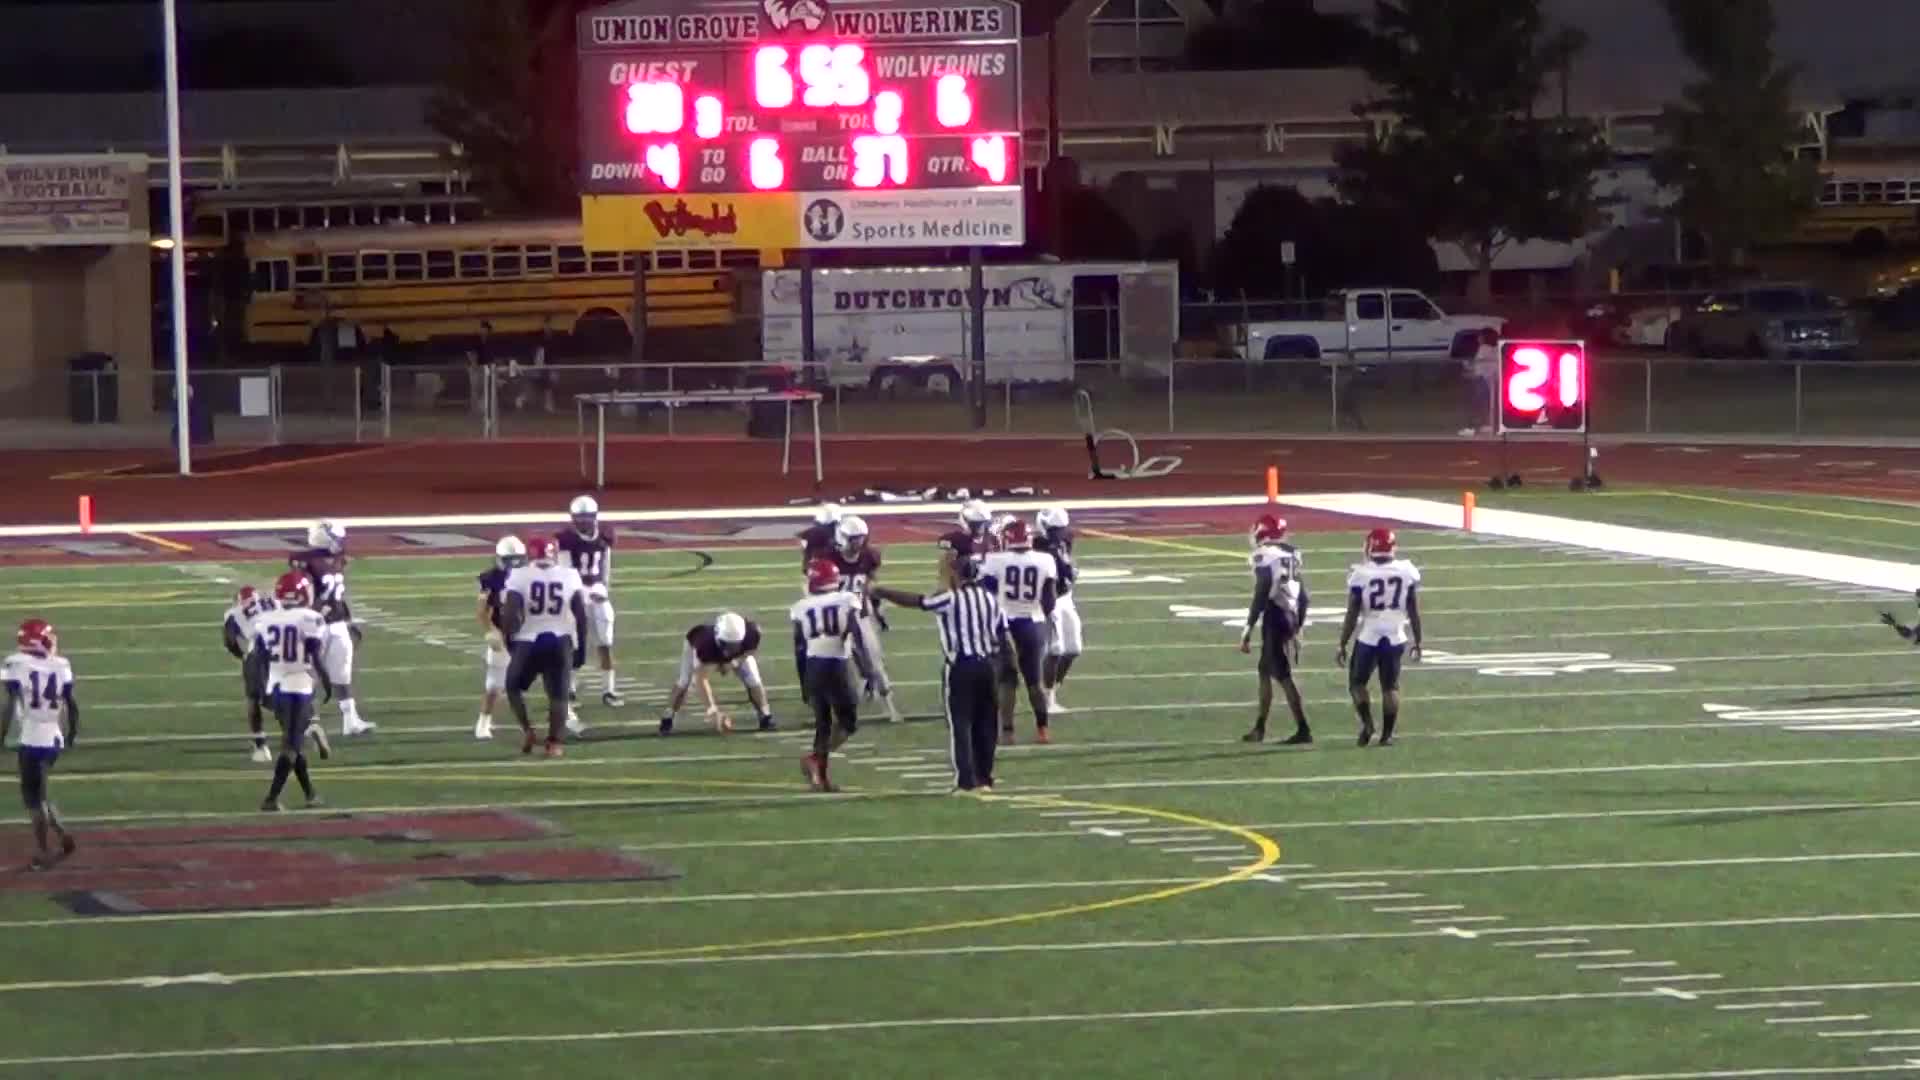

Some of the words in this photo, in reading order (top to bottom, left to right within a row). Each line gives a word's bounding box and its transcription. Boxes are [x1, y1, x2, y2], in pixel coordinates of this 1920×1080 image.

[592, 15, 670, 44] UNION
[676, 13, 758, 42] GROVE
[833, 7, 1001, 38] WOLVERINES
[609, 61, 697, 84] GUEST
[876, 53, 1006, 78] WOLVERINES
[936, 74, 972, 127] 6
[726, 115, 758, 132] TOL
[646, 142, 681, 189] 4
[702, 148, 726, 165] TO
[801, 147, 848, 163] BALL
[852, 135, 908, 187] 37
[927, 156, 970, 173] QTR.
[971, 135, 1006, 182] 4
[590, 163, 646, 180] DOWN
[700, 168, 726, 184] GO
[823, 165, 848, 181] ON
[851, 221, 916, 242] Sports
[921, 218, 1014, 238] Medicine
[1508, 347, 1579, 412] 21
[1004, 564, 1039, 601] 99
[1368, 576, 1403, 611] 27
[528, 581, 564, 616] 95
[805, 604, 841, 638] 10
[266, 624, 298, 664] 20
[28, 670, 59, 710] 14
